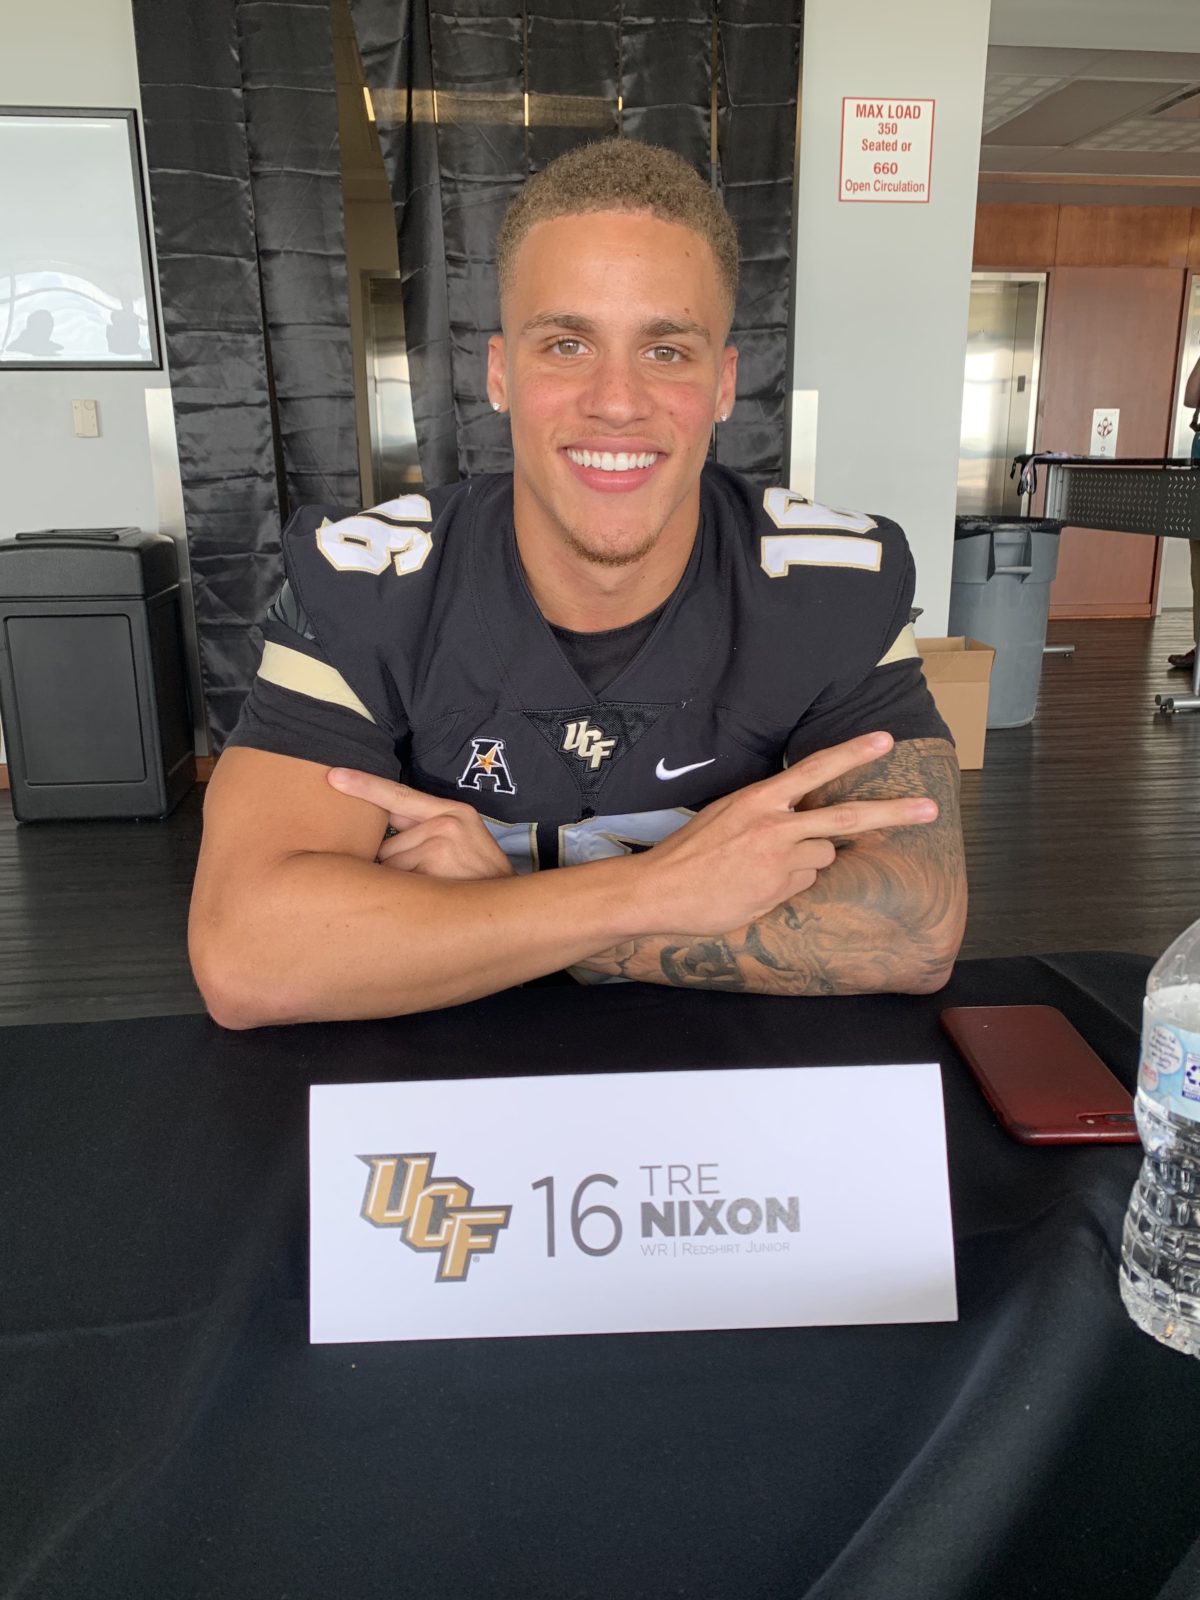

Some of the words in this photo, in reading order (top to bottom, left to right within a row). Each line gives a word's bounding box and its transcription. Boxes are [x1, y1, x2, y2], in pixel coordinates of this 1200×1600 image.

[856, 104, 884, 119] MAX
[888, 104, 921, 120] LOAD
[878, 122, 898, 135] 350
[861, 138, 898, 152] Seated
[901, 142, 912, 152] or
[873, 162, 898, 175] 660
[845, 179, 871, 195] Open
[873, 179, 925, 193] Circulation
[560, 717, 618, 771] UCF
[639, 1163, 720, 1196] TRE
[354, 1152, 513, 1283] UCF
[531, 1173, 623, 1258] 16
[640, 1196, 801, 1238] NIXON
[640, 1243, 668, 1257] WR
